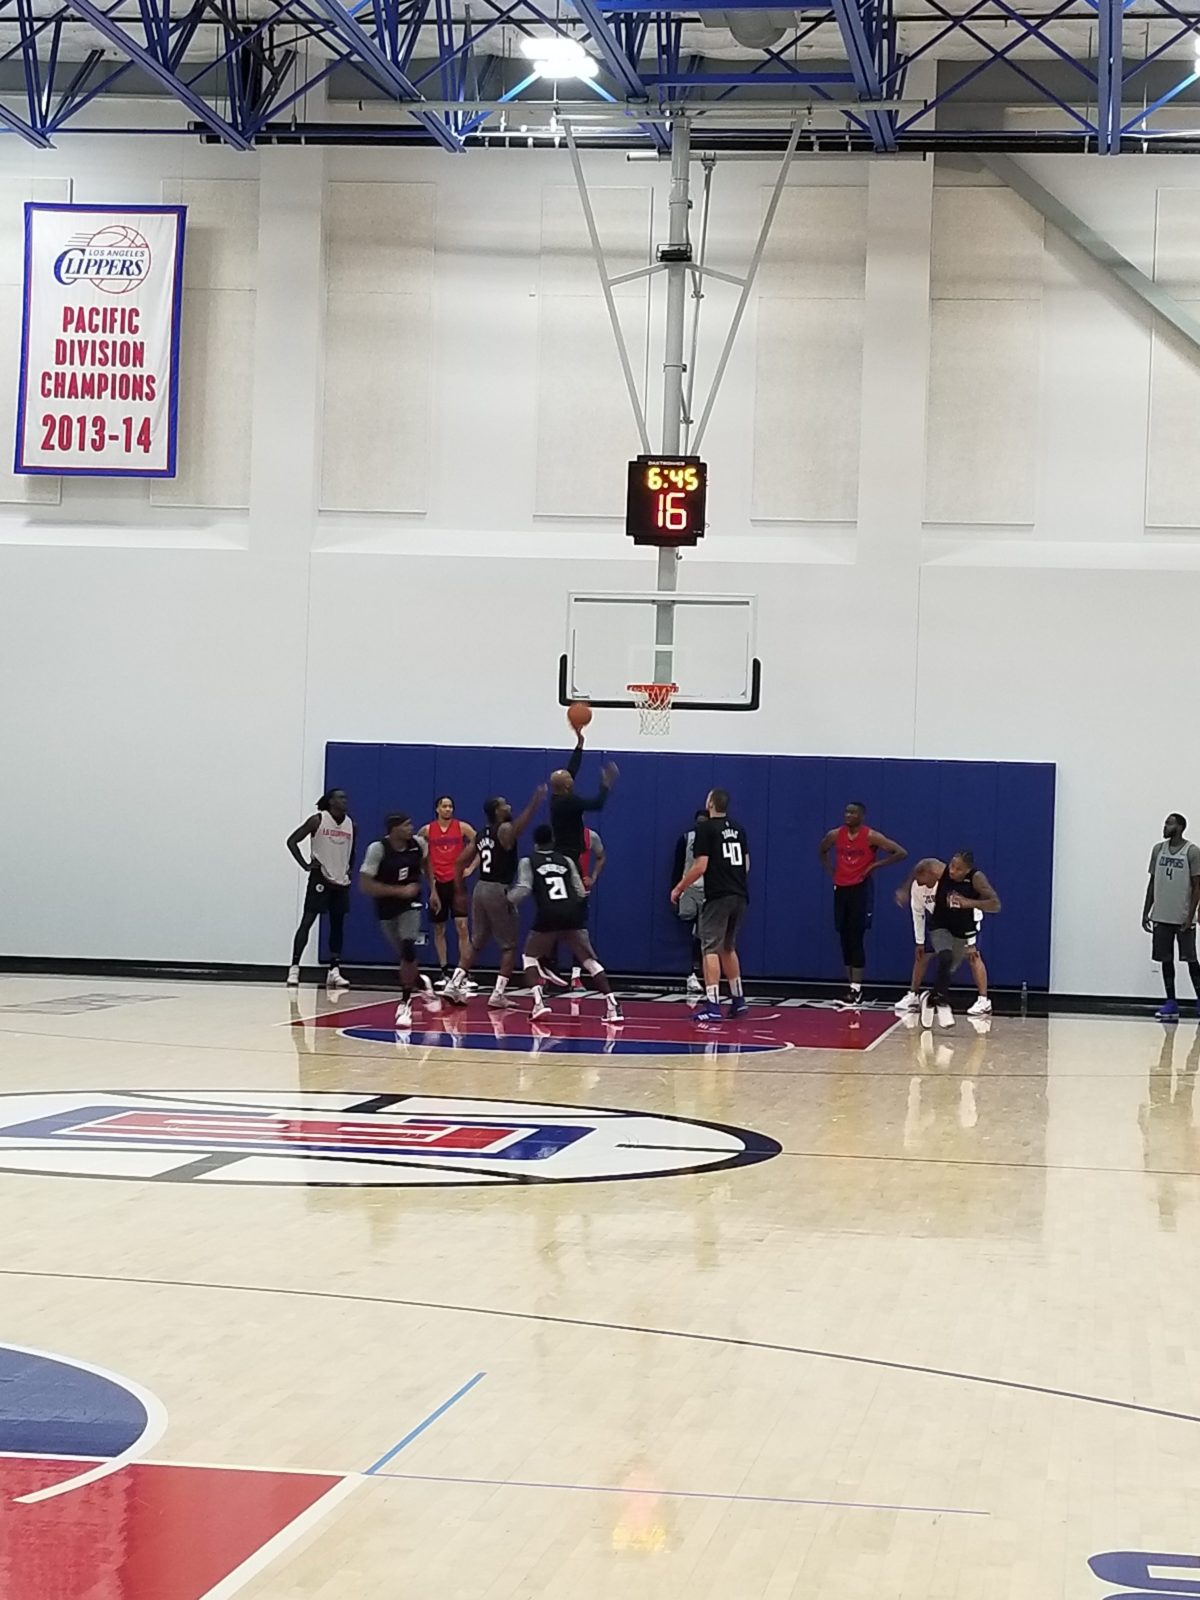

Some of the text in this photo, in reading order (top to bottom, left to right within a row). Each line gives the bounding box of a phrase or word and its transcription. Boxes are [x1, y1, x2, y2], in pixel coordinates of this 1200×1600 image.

[54, 248, 144, 285] CLIPPERS
[107, 250, 146, 258] ANGELES
[62, 306, 140, 335] PACIFIC
[55, 339, 145, 368] DIVISION
[40, 371, 156, 402] CHAMPIONS
[40, 414, 151, 454] 2013-14
[648, 467, 698, 491] 6:45
[657, 493, 687, 530] 16
[481, 849, 492, 873] 2
[723, 843, 742, 865] 40
[1166, 868, 1173, 880] 4
